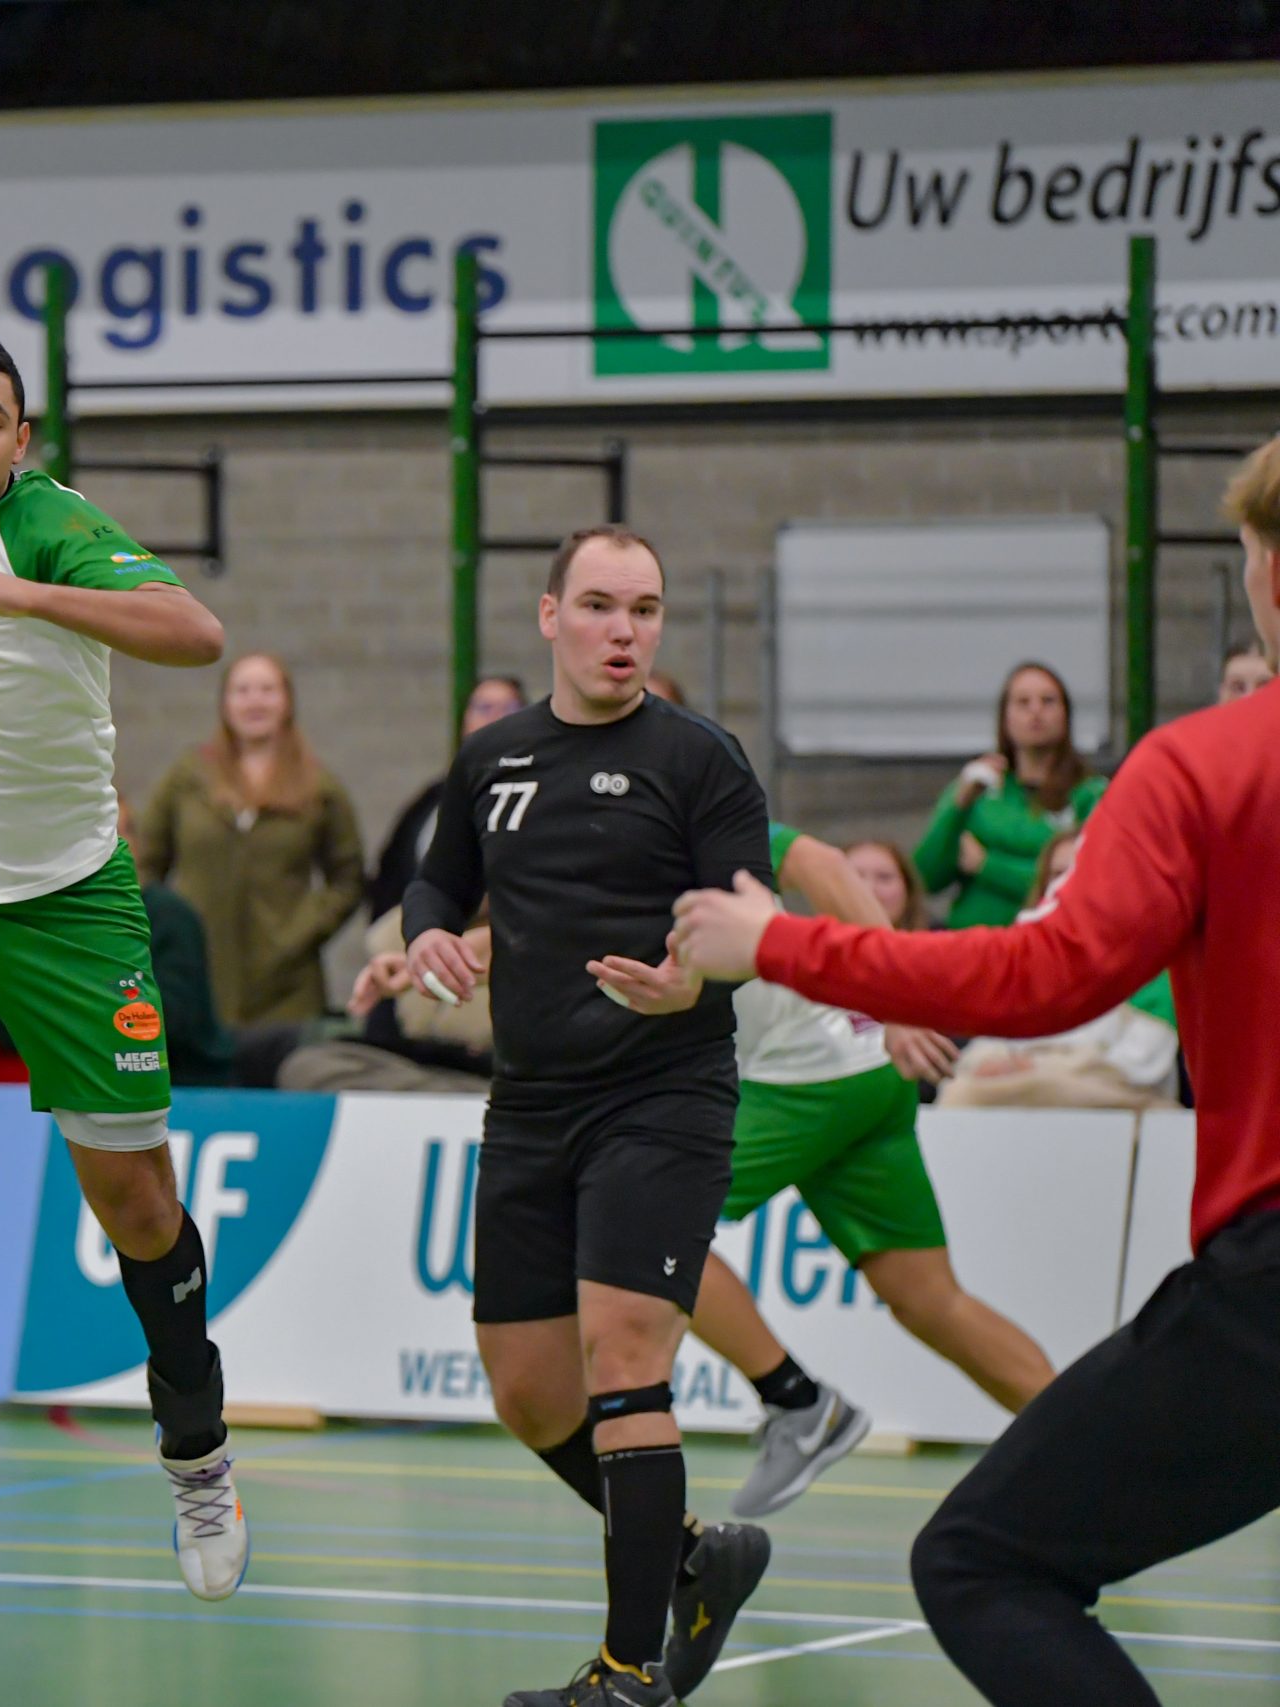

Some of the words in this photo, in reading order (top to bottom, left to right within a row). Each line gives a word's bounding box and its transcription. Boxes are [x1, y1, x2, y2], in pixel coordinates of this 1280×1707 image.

[845, 148, 968, 231] Uw
[993, 128, 1280, 242] bedrijfs
[487, 781, 539, 832] 77
